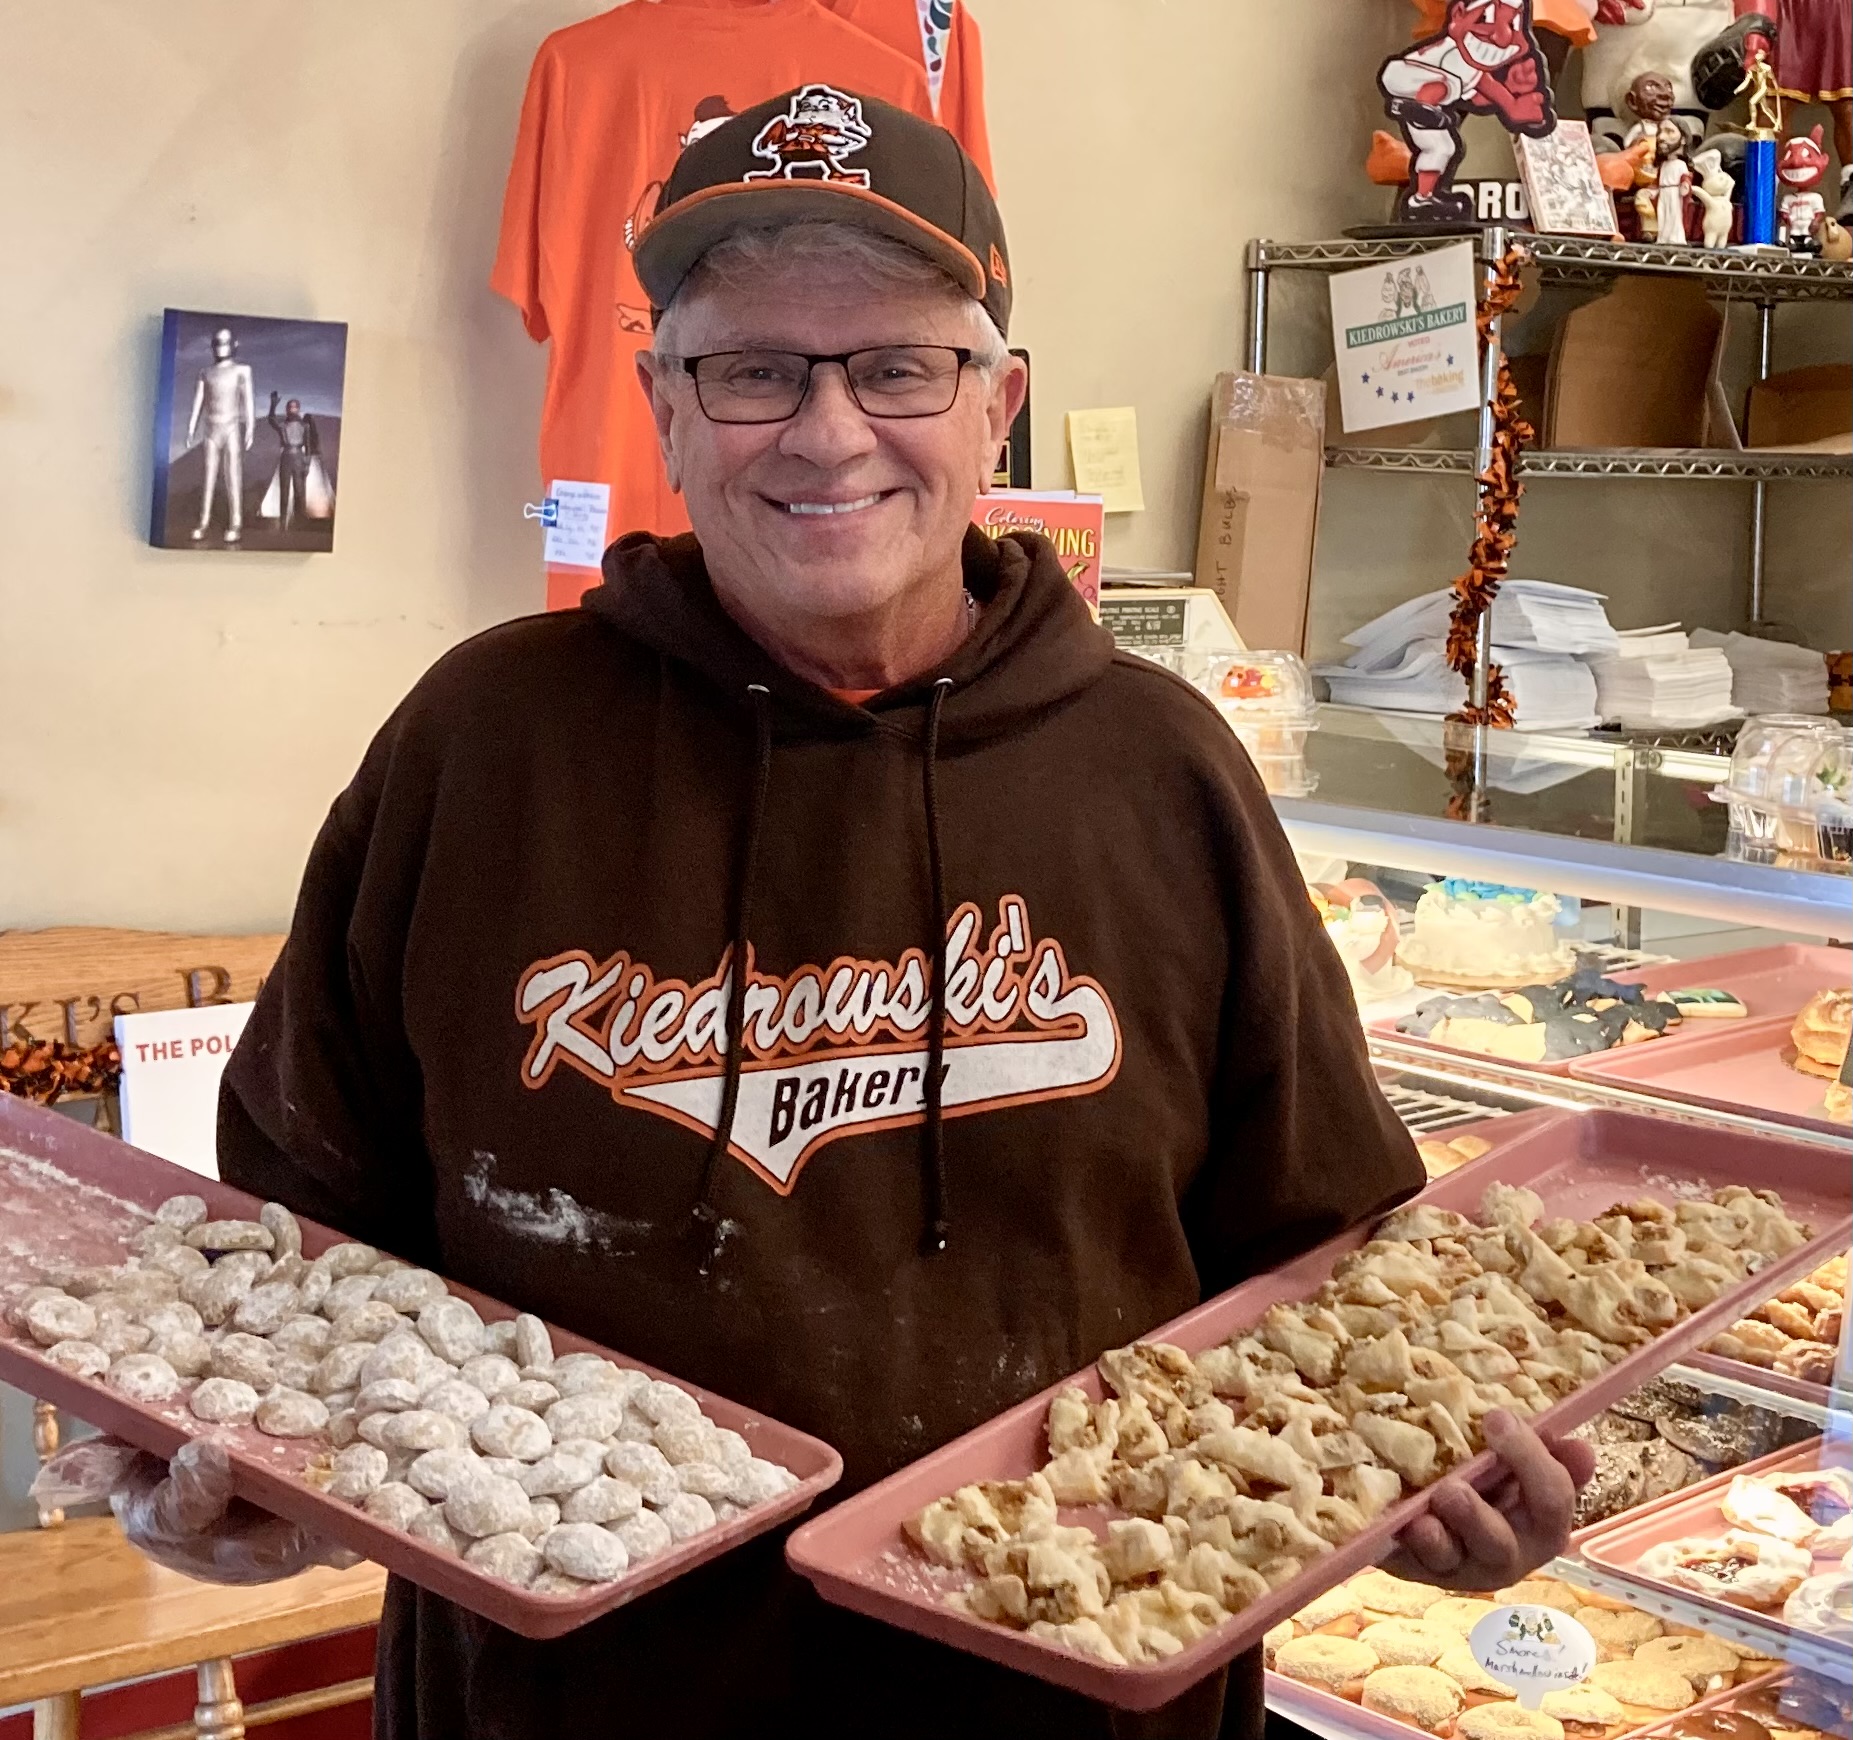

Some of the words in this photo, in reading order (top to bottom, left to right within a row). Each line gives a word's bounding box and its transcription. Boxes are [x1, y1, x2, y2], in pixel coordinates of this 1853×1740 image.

[1453, 182, 1530, 219] RO
[1348, 315, 1425, 346] KIEDROWSKI'S
[1427, 306, 1465, 330] BAKERY
[522, 896, 1072, 1088] Kiedrowski's
[136, 1040, 183, 1063] THE
